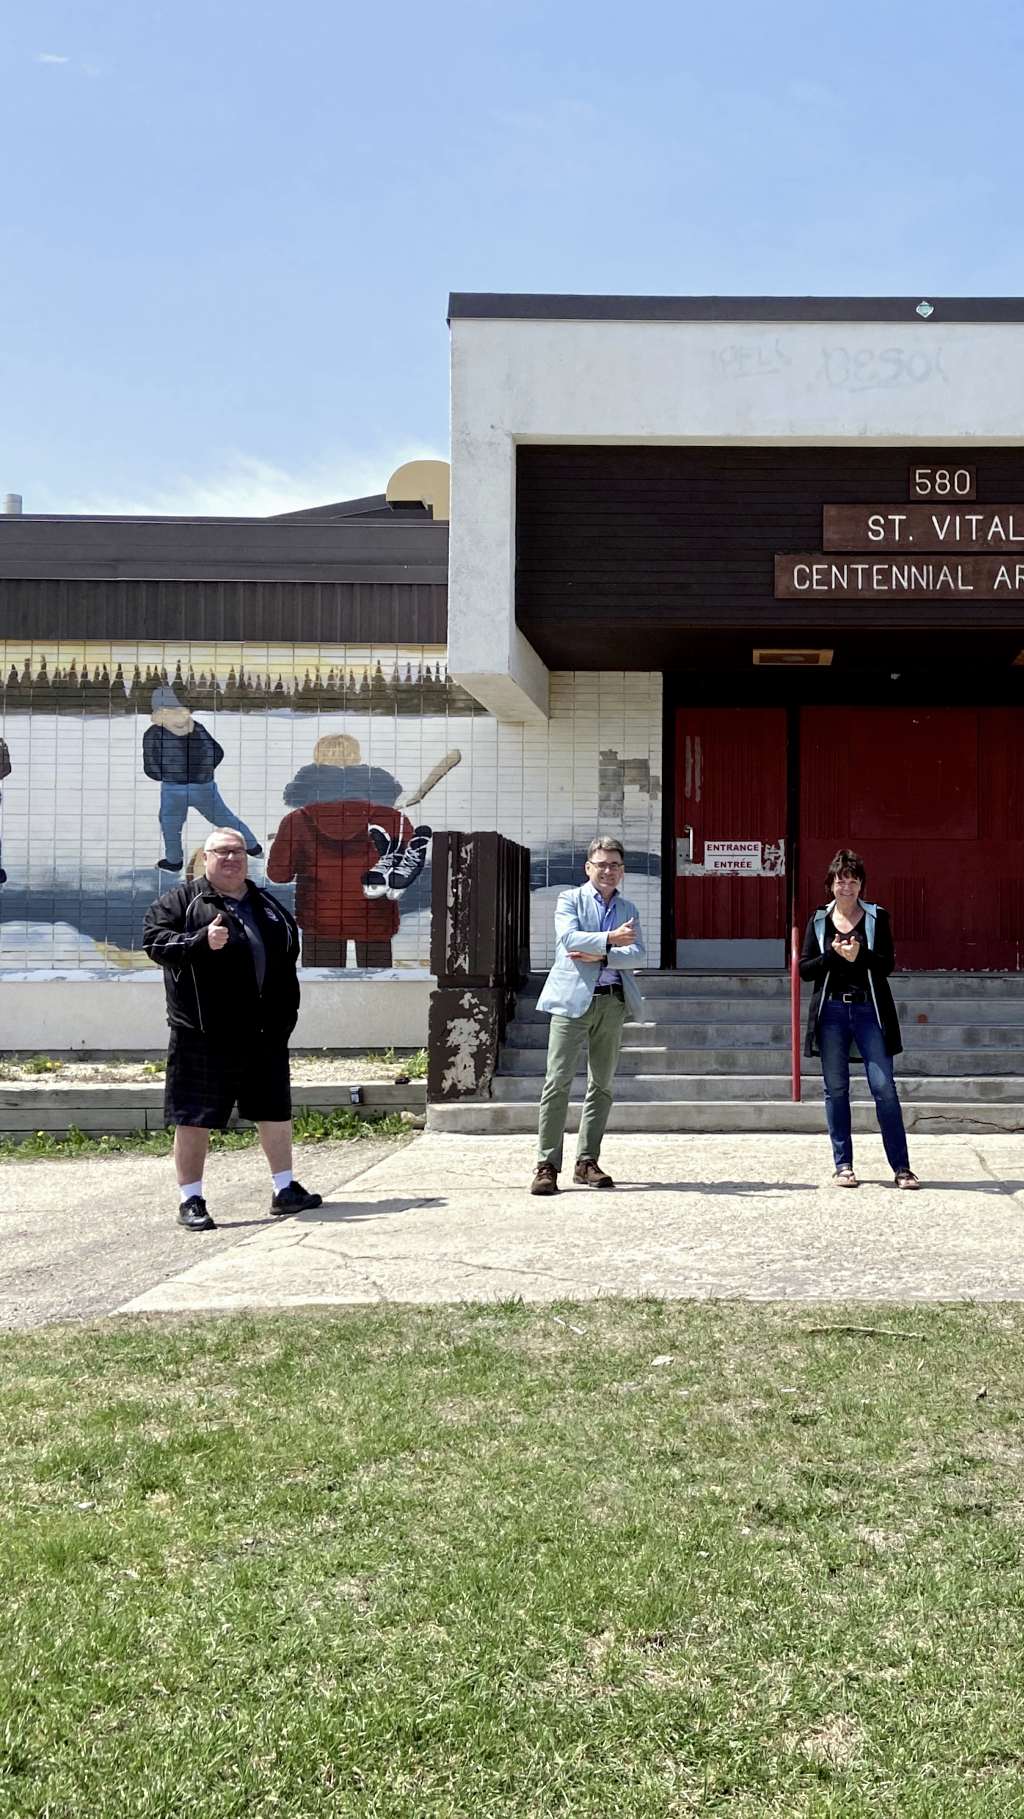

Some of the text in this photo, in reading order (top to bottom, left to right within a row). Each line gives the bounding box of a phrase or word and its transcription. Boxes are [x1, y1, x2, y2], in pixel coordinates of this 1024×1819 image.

[915, 469, 971, 494] 580
[868, 515, 1024, 541] ST. VITAL
[793, 564, 974, 590] CENTENNIAL
[706, 844, 760, 852] ENTRANCE
[713, 857, 753, 869] ENTRÉE
